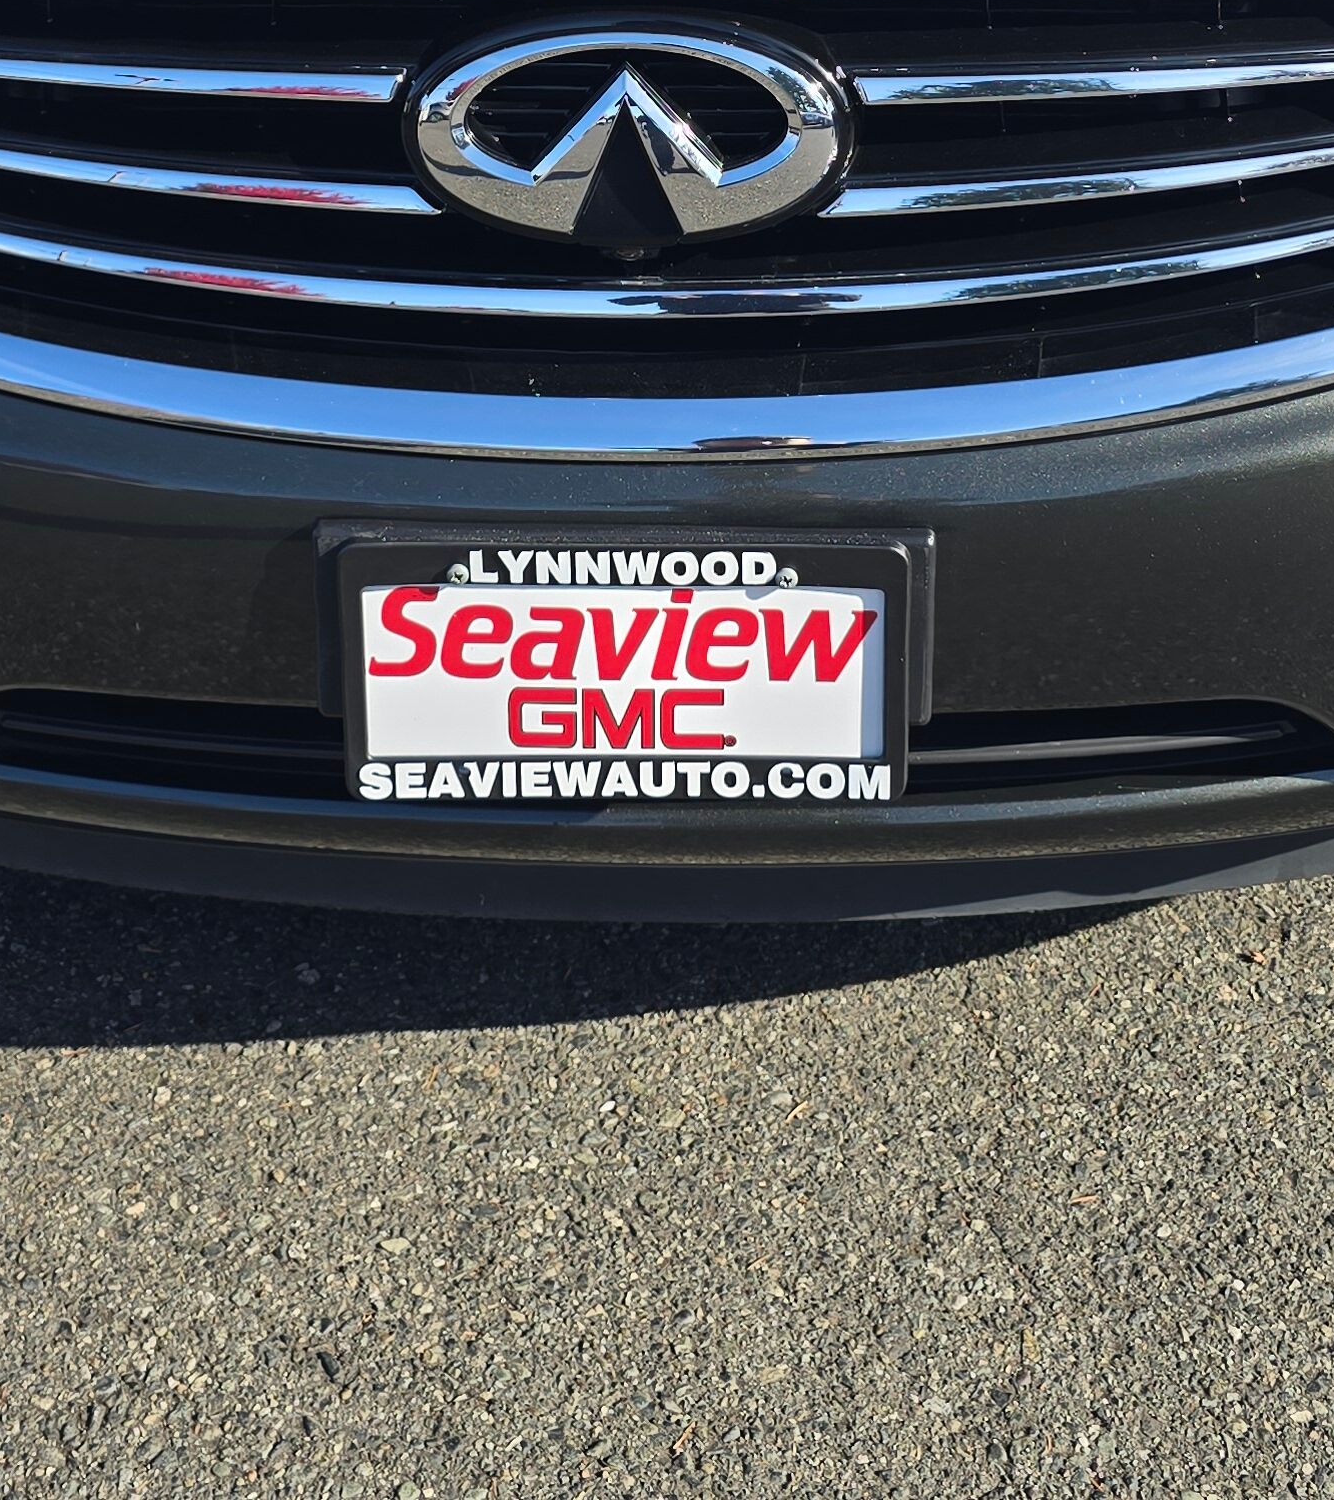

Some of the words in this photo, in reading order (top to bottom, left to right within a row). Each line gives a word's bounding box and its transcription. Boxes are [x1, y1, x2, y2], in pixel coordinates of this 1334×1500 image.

[469, 550, 777, 586] LYNNWOOD
[368, 587, 878, 683] Seaview
[508, 687, 726, 750] GMC
[358, 761, 892, 801] SEAVIEWAUTO.COM
